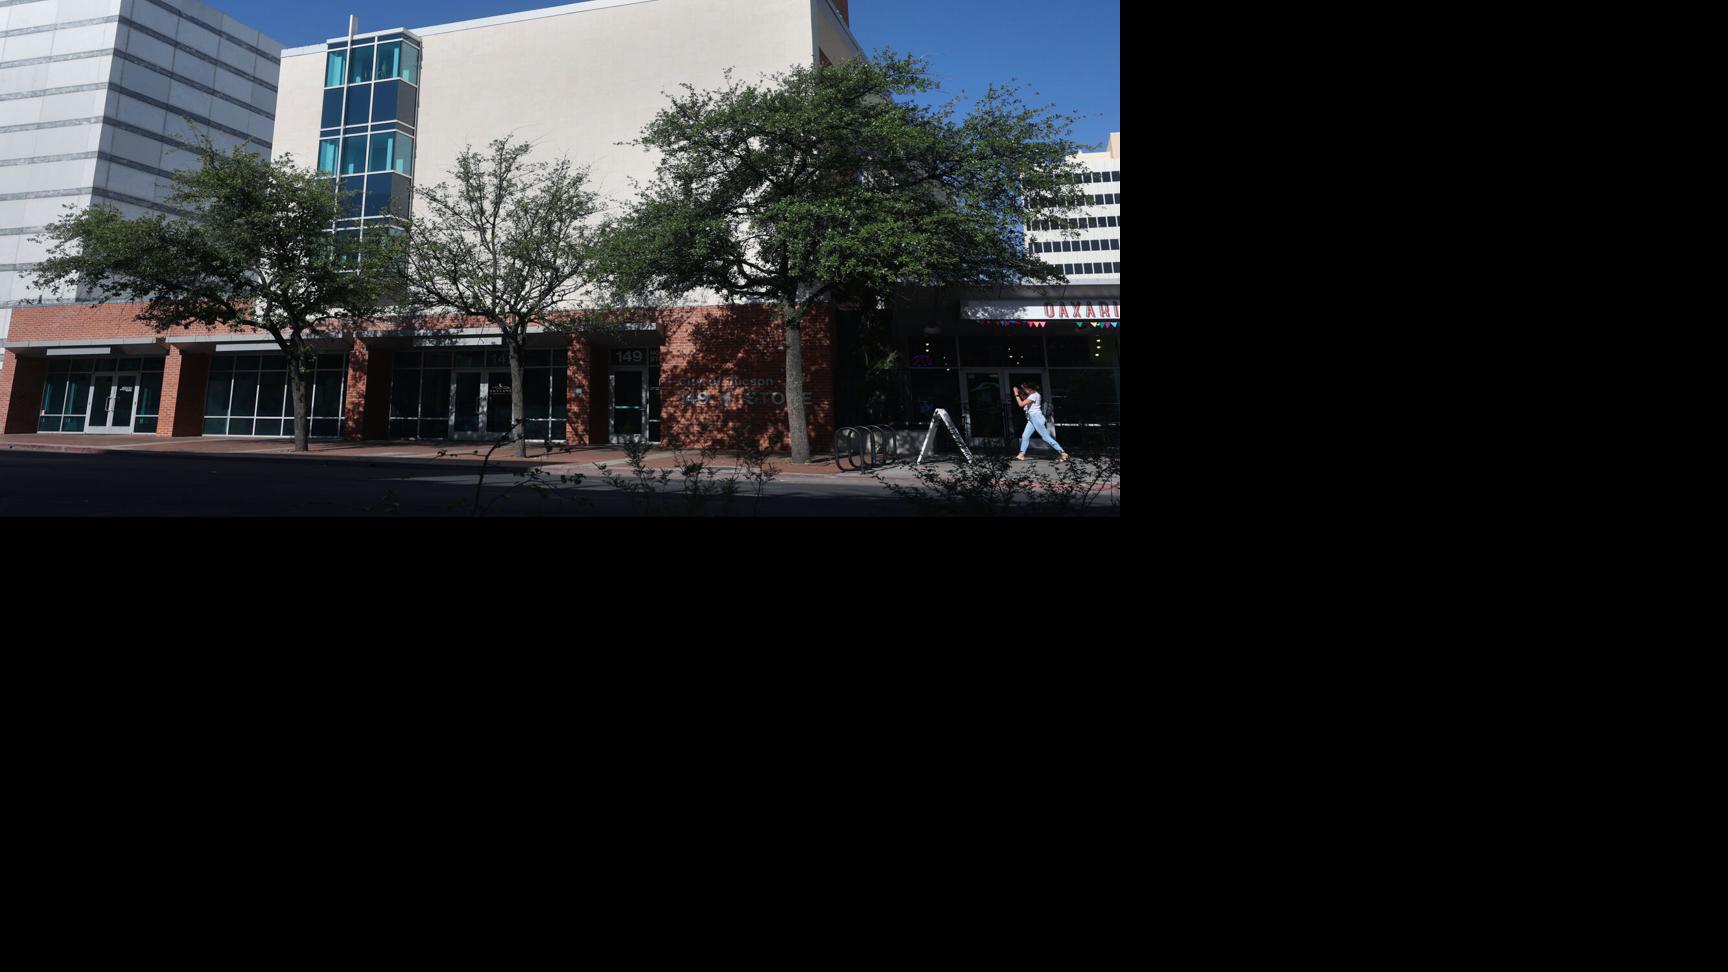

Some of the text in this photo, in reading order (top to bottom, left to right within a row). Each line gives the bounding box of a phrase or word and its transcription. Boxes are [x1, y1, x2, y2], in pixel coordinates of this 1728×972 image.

[616, 350, 642, 363] 149
[728, 377, 774, 387] Tucson
[744, 391, 813, 406] STOE
